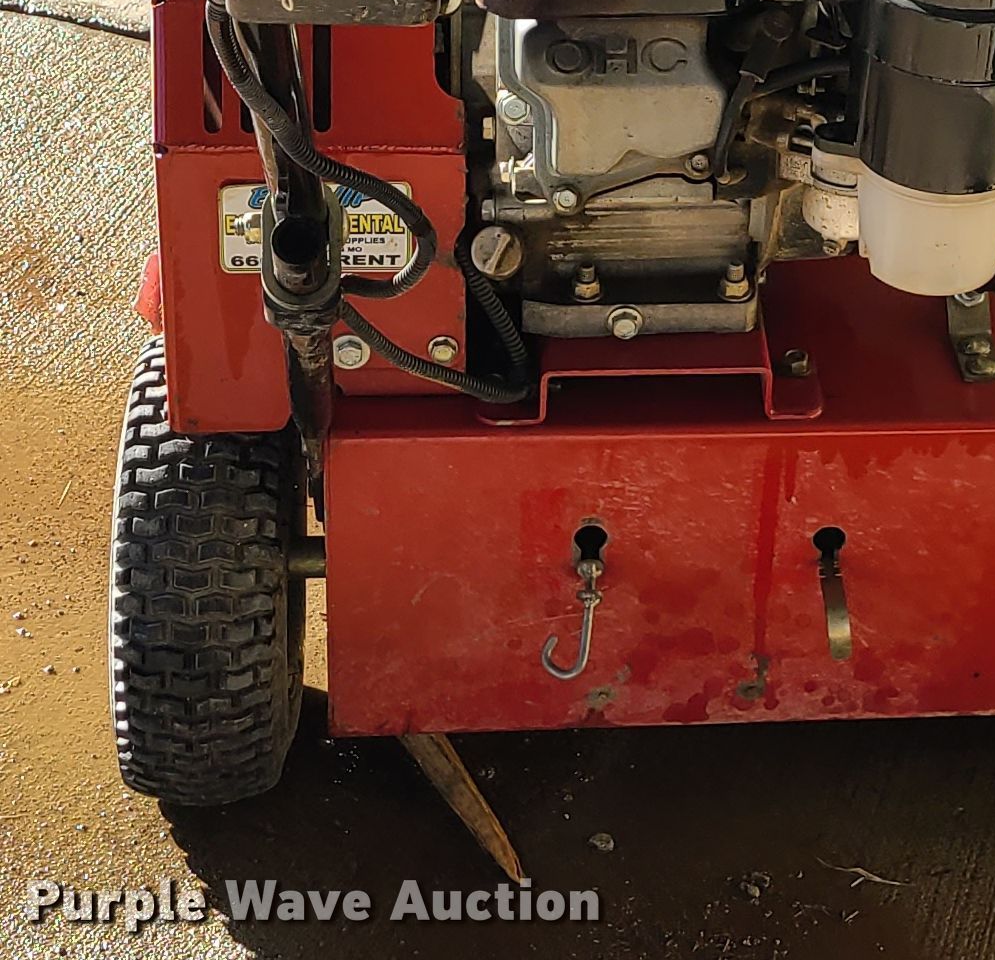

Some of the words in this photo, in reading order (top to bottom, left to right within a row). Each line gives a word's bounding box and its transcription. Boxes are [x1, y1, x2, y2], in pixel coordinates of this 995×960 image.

[543, 37, 689, 75] OHC
[346, 213, 405, 235] ENTAL
[230, 255, 262, 267] 66
